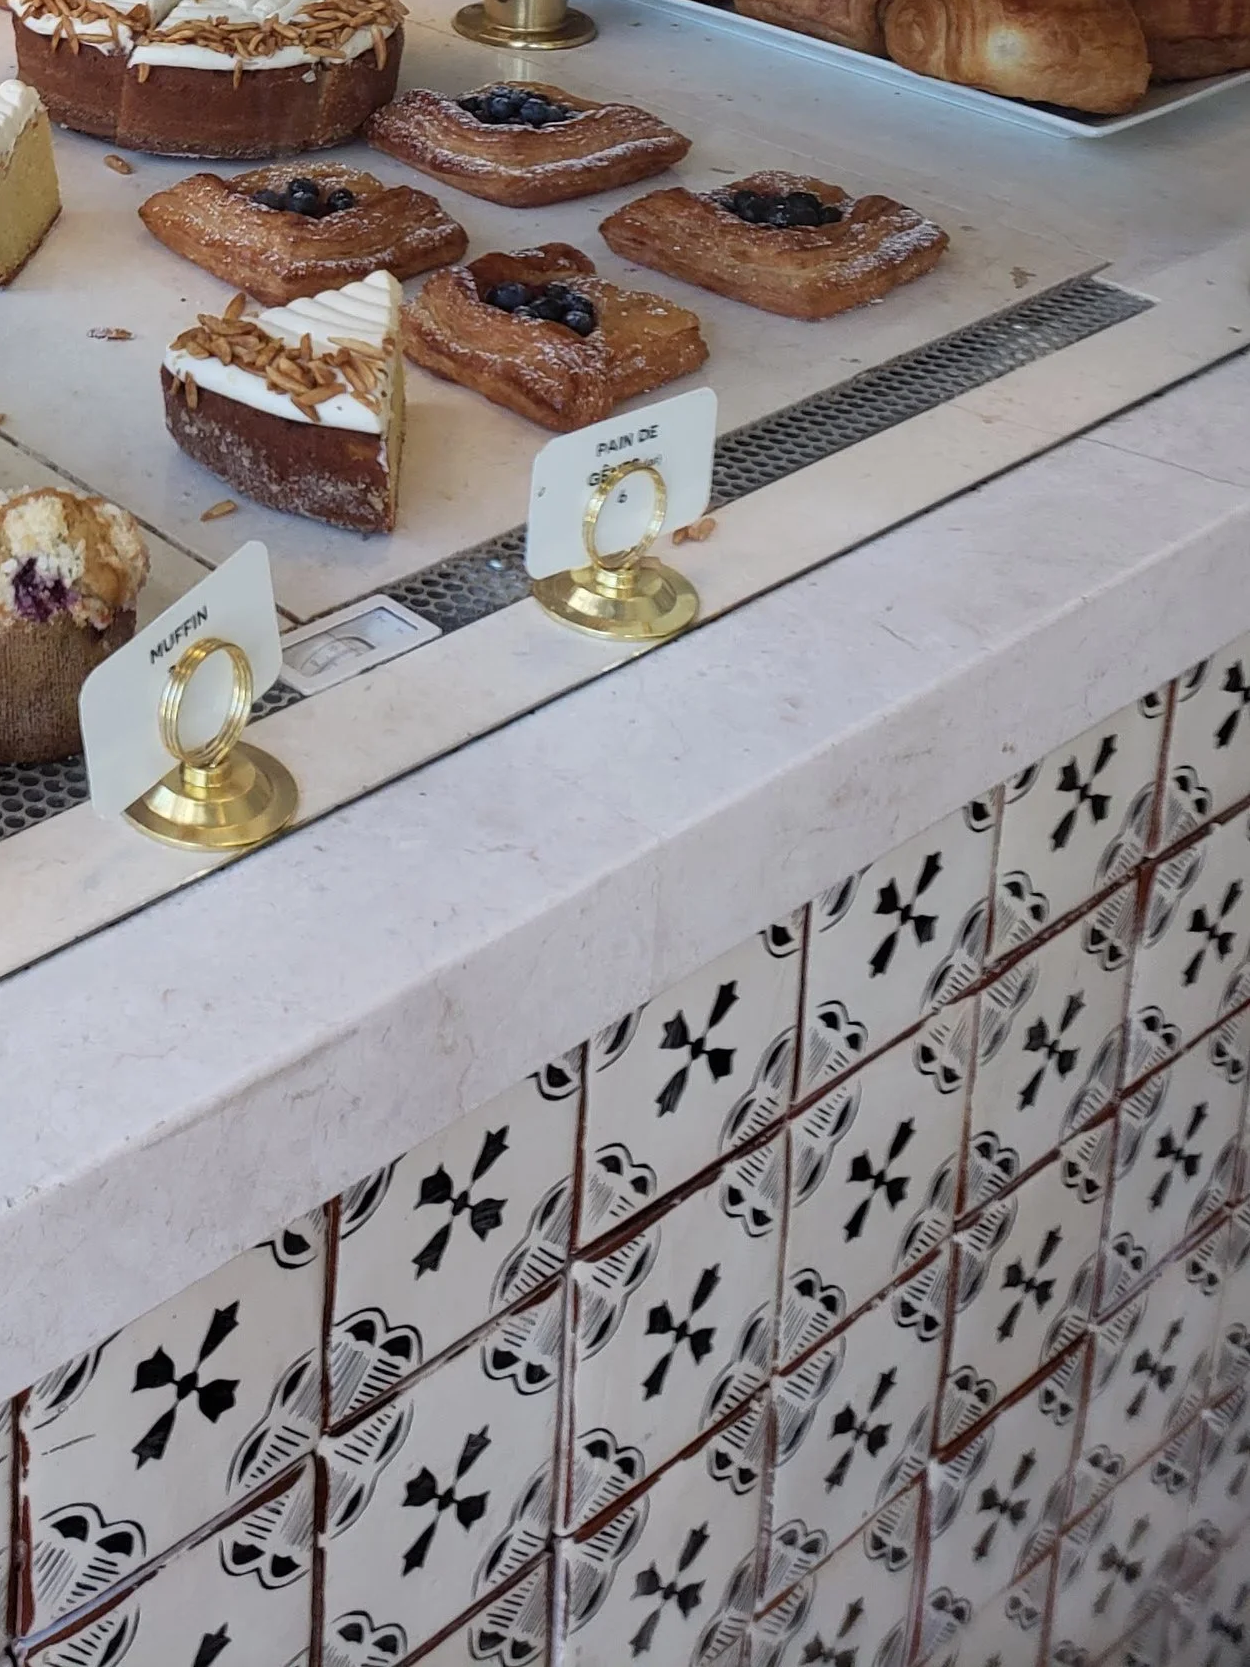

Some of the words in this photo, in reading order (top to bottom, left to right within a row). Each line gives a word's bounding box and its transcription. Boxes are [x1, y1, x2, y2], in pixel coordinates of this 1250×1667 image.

[596, 432, 635, 458] PAIN
[637, 424, 660, 443] DE
[149, 604, 209, 664] MUFFIN
